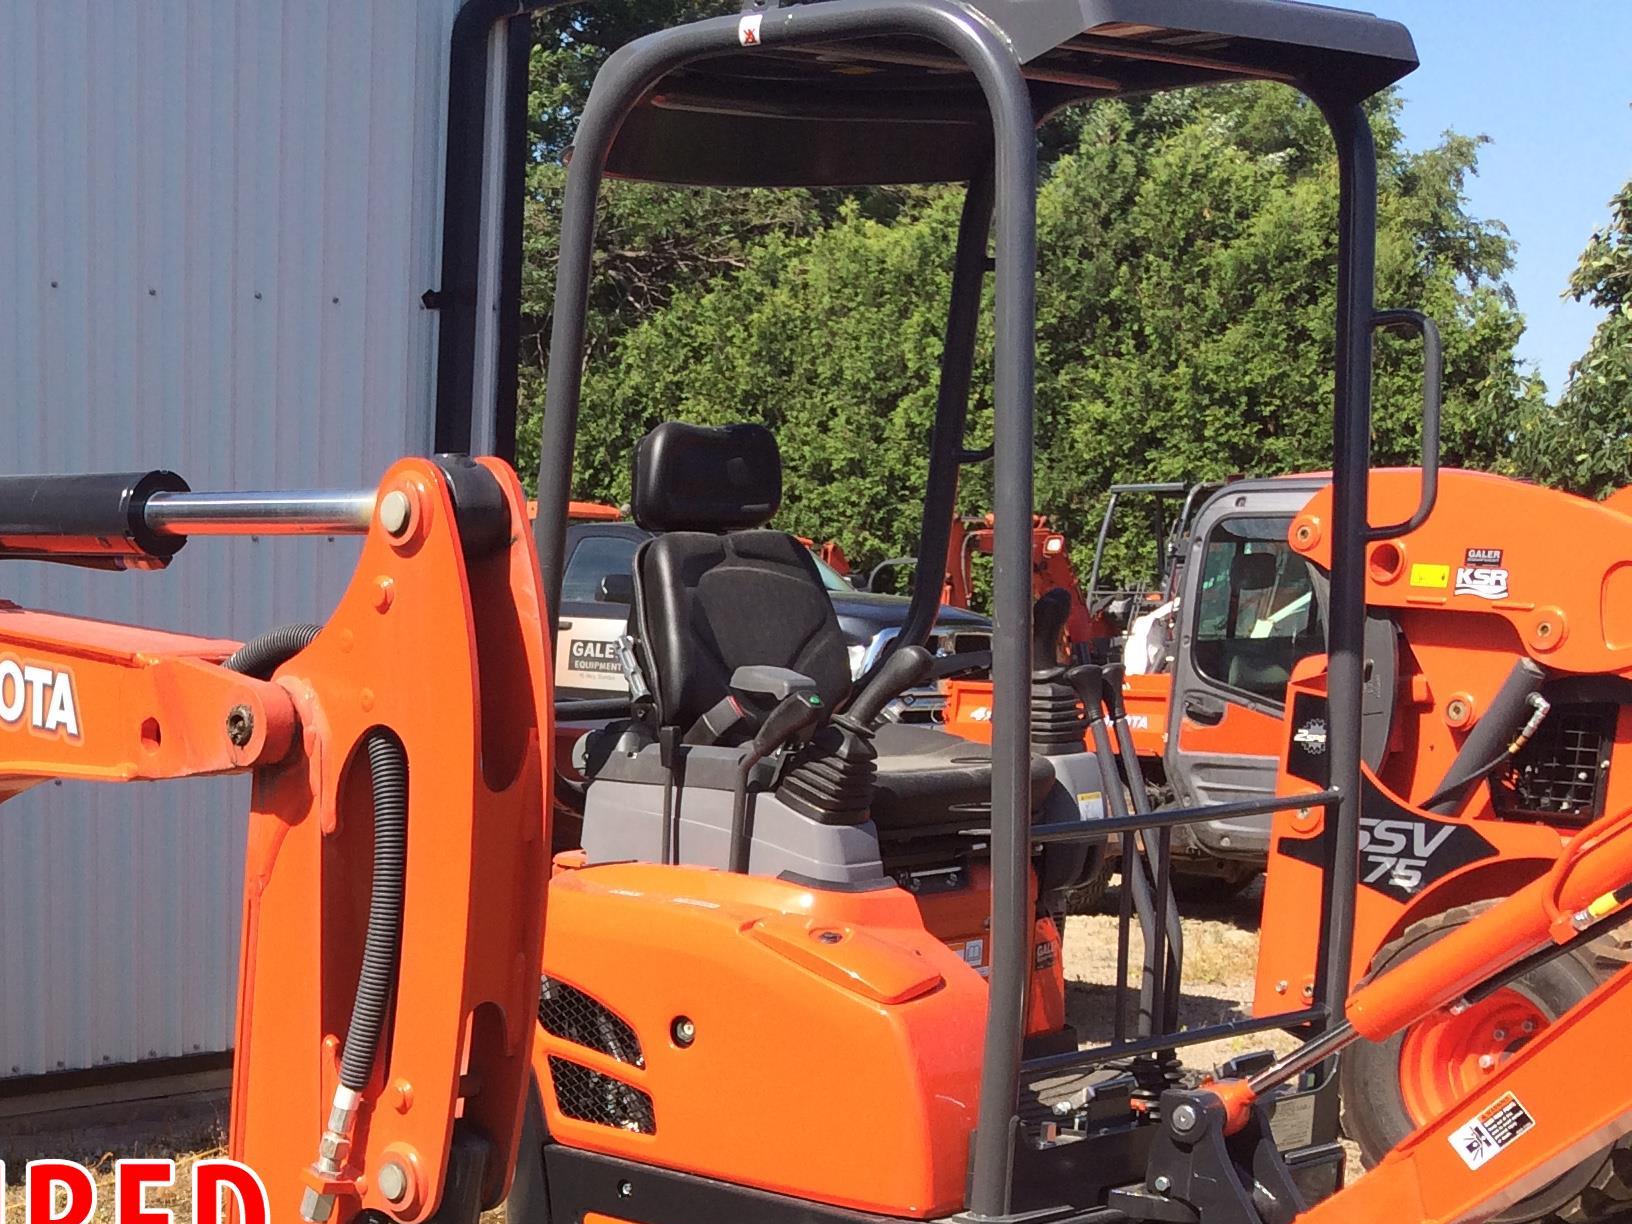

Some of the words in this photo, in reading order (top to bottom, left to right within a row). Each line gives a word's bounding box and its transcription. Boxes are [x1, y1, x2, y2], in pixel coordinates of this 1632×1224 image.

[1468, 549, 1500, 559] GALER
[1456, 568, 1508, 588] KSR
[572, 641, 620, 659] GALE
[574, 660, 622, 672] EQUIPMENT
[1362, 855, 1427, 888] 75
